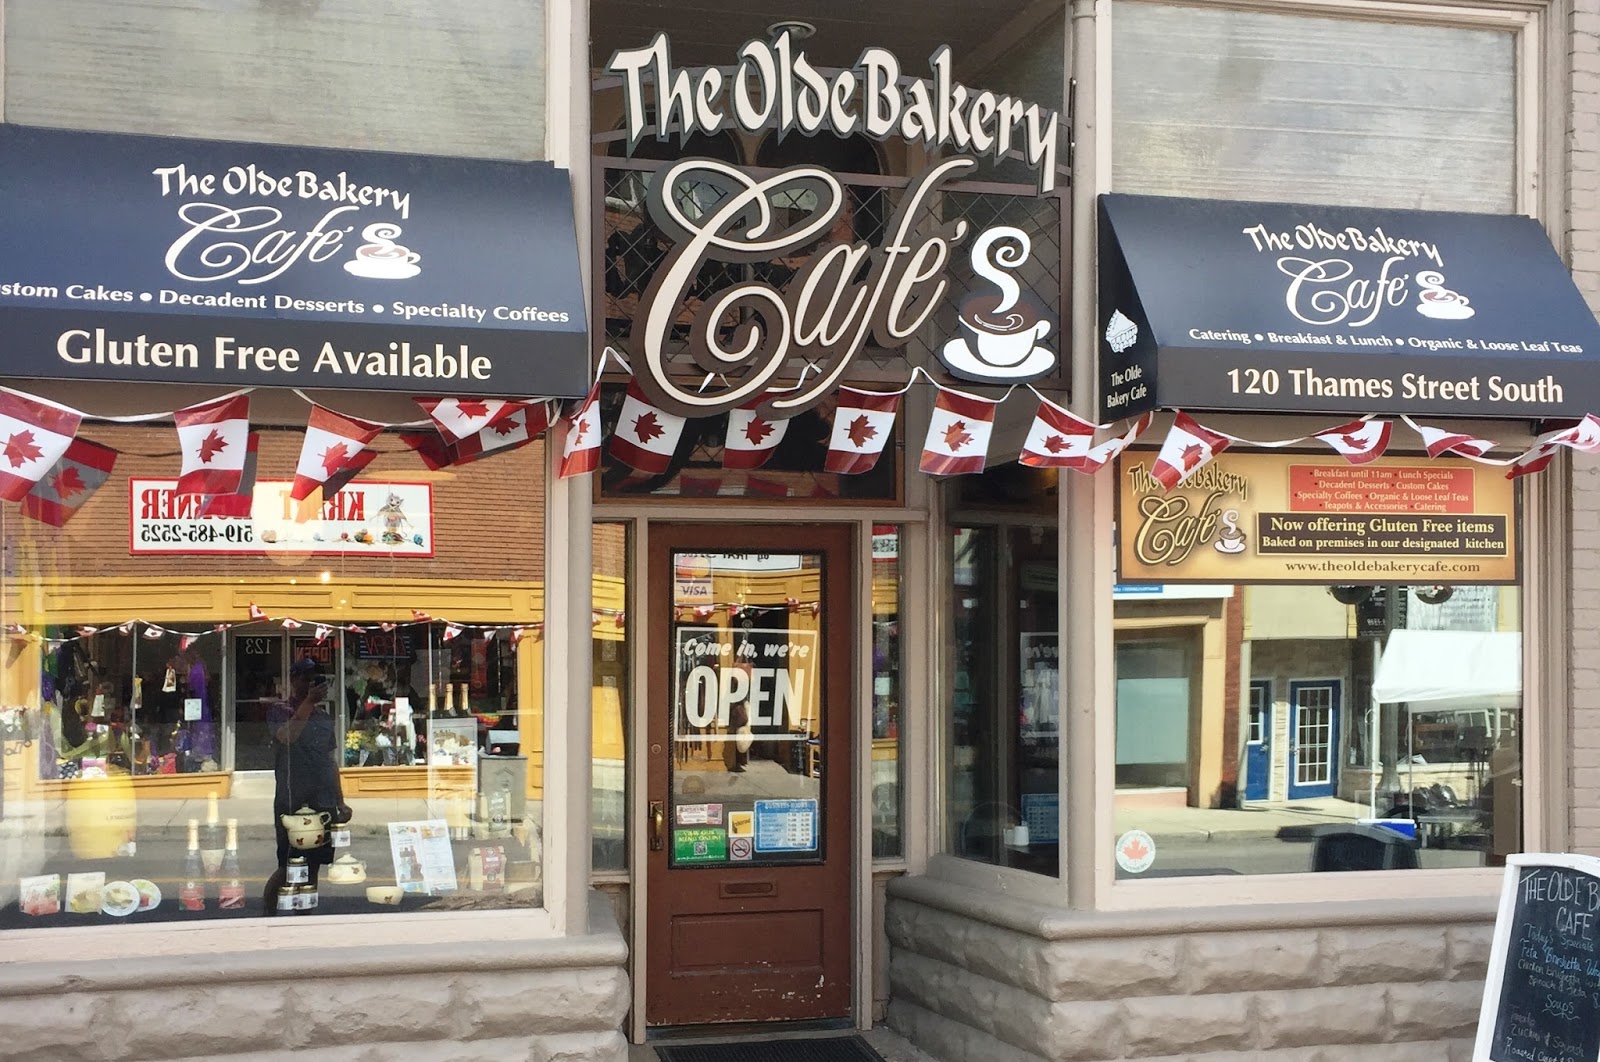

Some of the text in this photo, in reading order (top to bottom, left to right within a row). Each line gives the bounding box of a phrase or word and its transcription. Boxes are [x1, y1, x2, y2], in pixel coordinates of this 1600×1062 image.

[608, 30, 1058, 194] The Olde Bakery
[153, 164, 410, 219] The Olde Bakery
[1243, 223, 1443, 267] The Olde Bakery
[0, 281, 569, 324] stom Cakes Decadent Desserts Specialty Coffees
[1189, 328, 1584, 354] Catering Breakfast & Lunch Organic & Loose Leaf Teas
[56, 328, 492, 381] Gluten Free Available
[1111, 364, 1142, 387] The Olde
[1227, 367, 1564, 403] 120 Thames Street South
[1107, 391, 1130, 408] Bakery
[1313, 469, 1453, 481] Breakfast until 11am Lunch Specials
[1318, 480, 1449, 491] Decadent Desserts Custom Cakes
[1297, 491, 1332, 501] Specialty
[1334, 491, 1363, 500] Coffees
[1369, 492, 1400, 502] Organic
[1411, 493, 1432, 501] Loose
[1434, 493, 1450, 501] Leaf
[1452, 494, 1469, 502] Teas
[1324, 502, 1352, 511] Teapots
[1364, 502, 1408, 510] Accessories
[1414, 502, 1446, 512] Catering
[1270, 517, 1495, 535] Now offering Gluten Free items
[1262, 536, 1505, 551] Baked on premises in our designated kitchen
[1286, 560, 1480, 575] www.theoldebakerycafe.com
[681, 585, 708, 596] VISA
[684, 638, 809, 658] Come in, we're
[685, 665, 805, 727] OPEN
[1519, 869, 1547, 904] THE
[1547, 871, 1585, 906] OLDE
[1556, 906, 1594, 940] CAFE
[1545, 994, 1574, 1018] Soups
